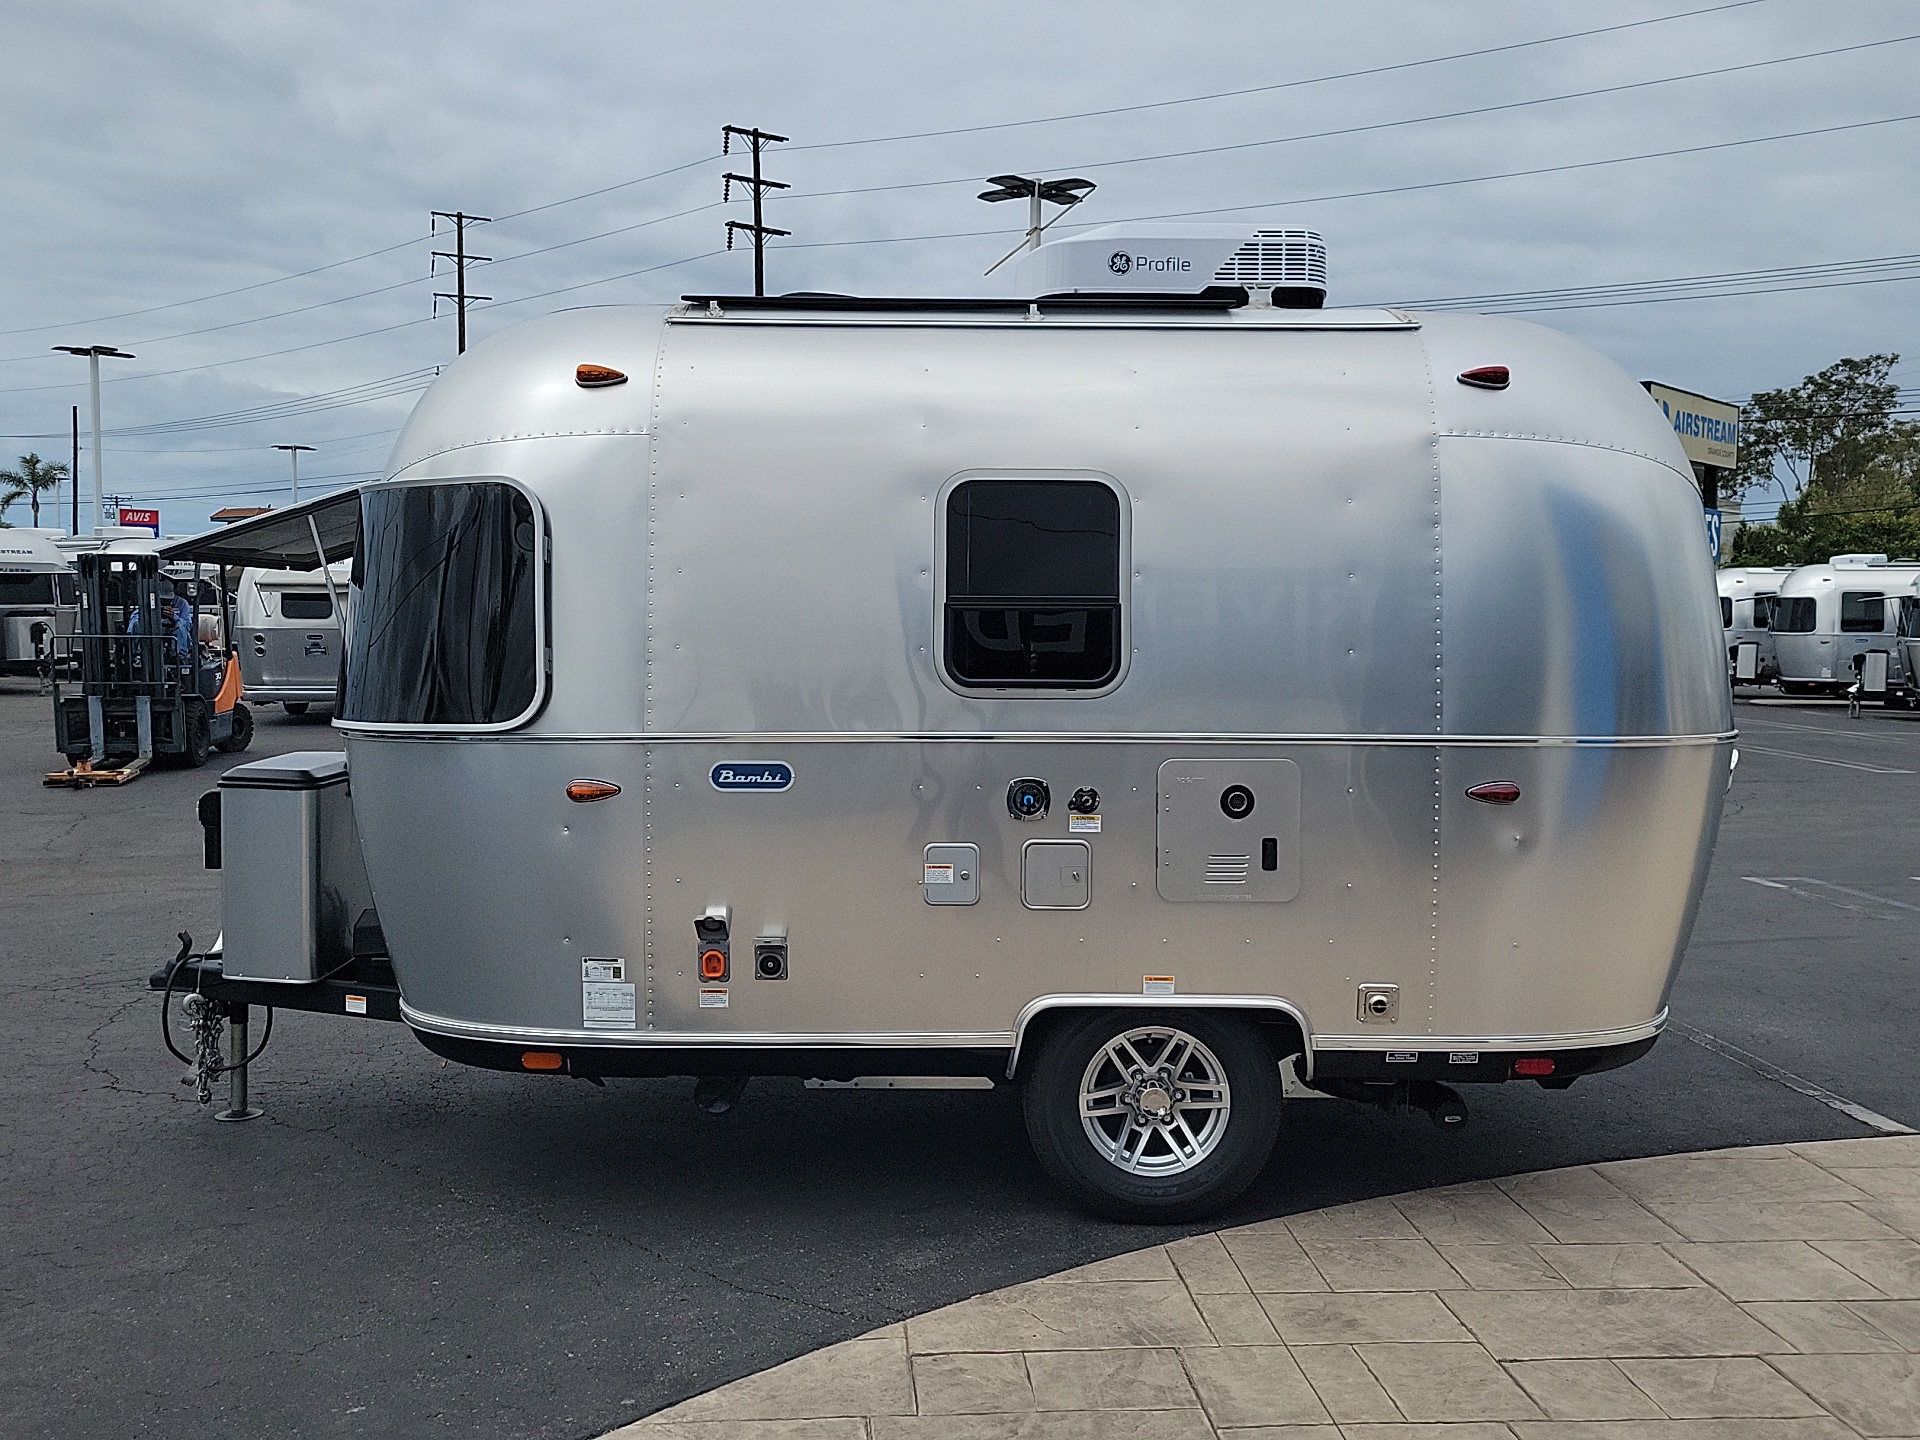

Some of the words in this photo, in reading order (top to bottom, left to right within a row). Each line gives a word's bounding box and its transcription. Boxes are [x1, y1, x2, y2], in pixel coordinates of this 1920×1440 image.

[1136, 256, 1191, 272] Profile
[1674, 409, 1736, 445] AIRSTREAM
[125, 511, 152, 522] AVIS
[718, 769, 786, 783] Bambi
